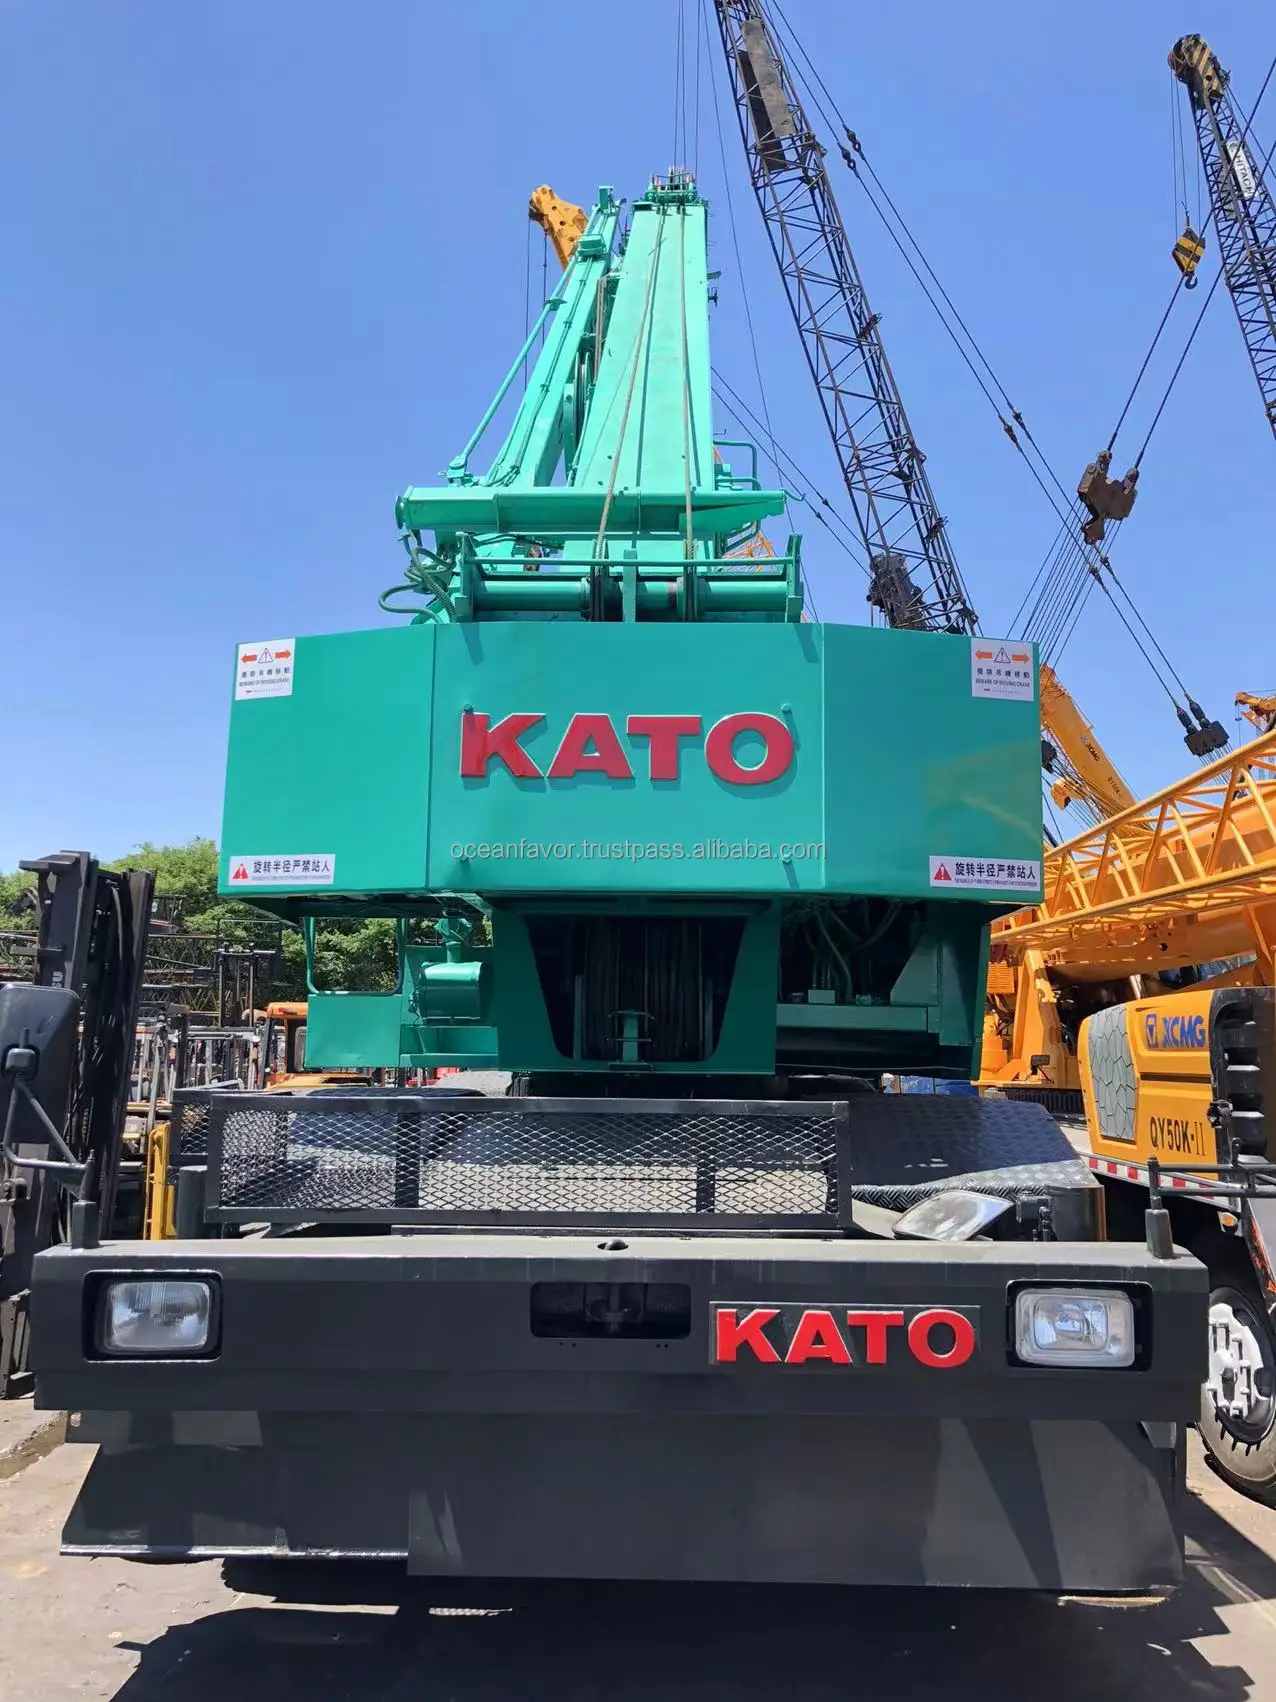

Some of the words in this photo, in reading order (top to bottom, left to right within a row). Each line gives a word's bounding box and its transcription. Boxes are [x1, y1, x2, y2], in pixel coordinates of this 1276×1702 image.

[1235, 153, 1253, 194] HITACH
[459, 712, 794, 785] KATO
[253, 859, 330, 874] 旋转半径严禁站人
[955, 862, 1036, 880] 旋转半径严禁站人
[1162, 1015, 1206, 1048] XCMG
[717, 1309, 975, 1368] KATO
